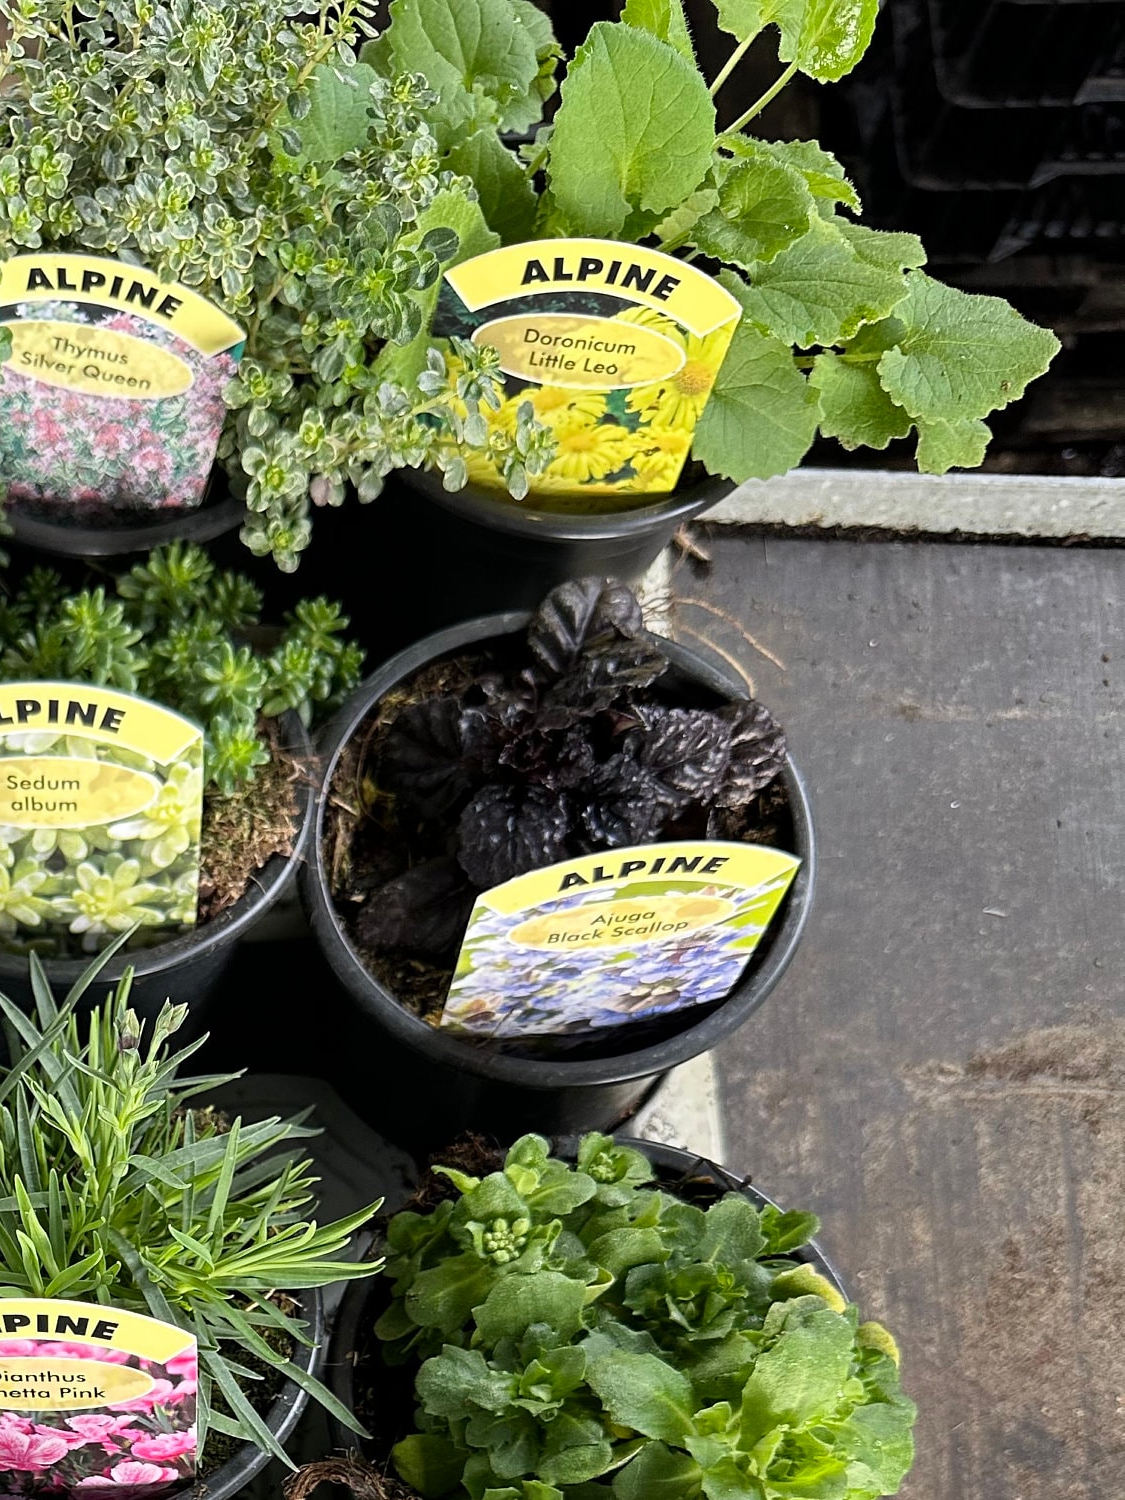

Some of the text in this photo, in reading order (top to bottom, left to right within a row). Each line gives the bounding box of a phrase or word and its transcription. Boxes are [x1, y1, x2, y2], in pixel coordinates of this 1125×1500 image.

[520, 257, 681, 301] ALPINE
[26, 267, 183, 320] ALPINE
[51, 336, 129, 365] Thymus
[523, 328, 636, 355] Doronicum
[19, 351, 151, 391] Silver Queen
[528, 352, 618, 375] Little Leo
[6, 775, 80, 791] Sedum
[11, 796, 78, 812] album
[557, 855, 730, 892] ALPINE
[590, 909, 656, 927] Ajuga
[547, 920, 690, 944] Black Scallop
[59, 1386, 106, 1399] Pink
